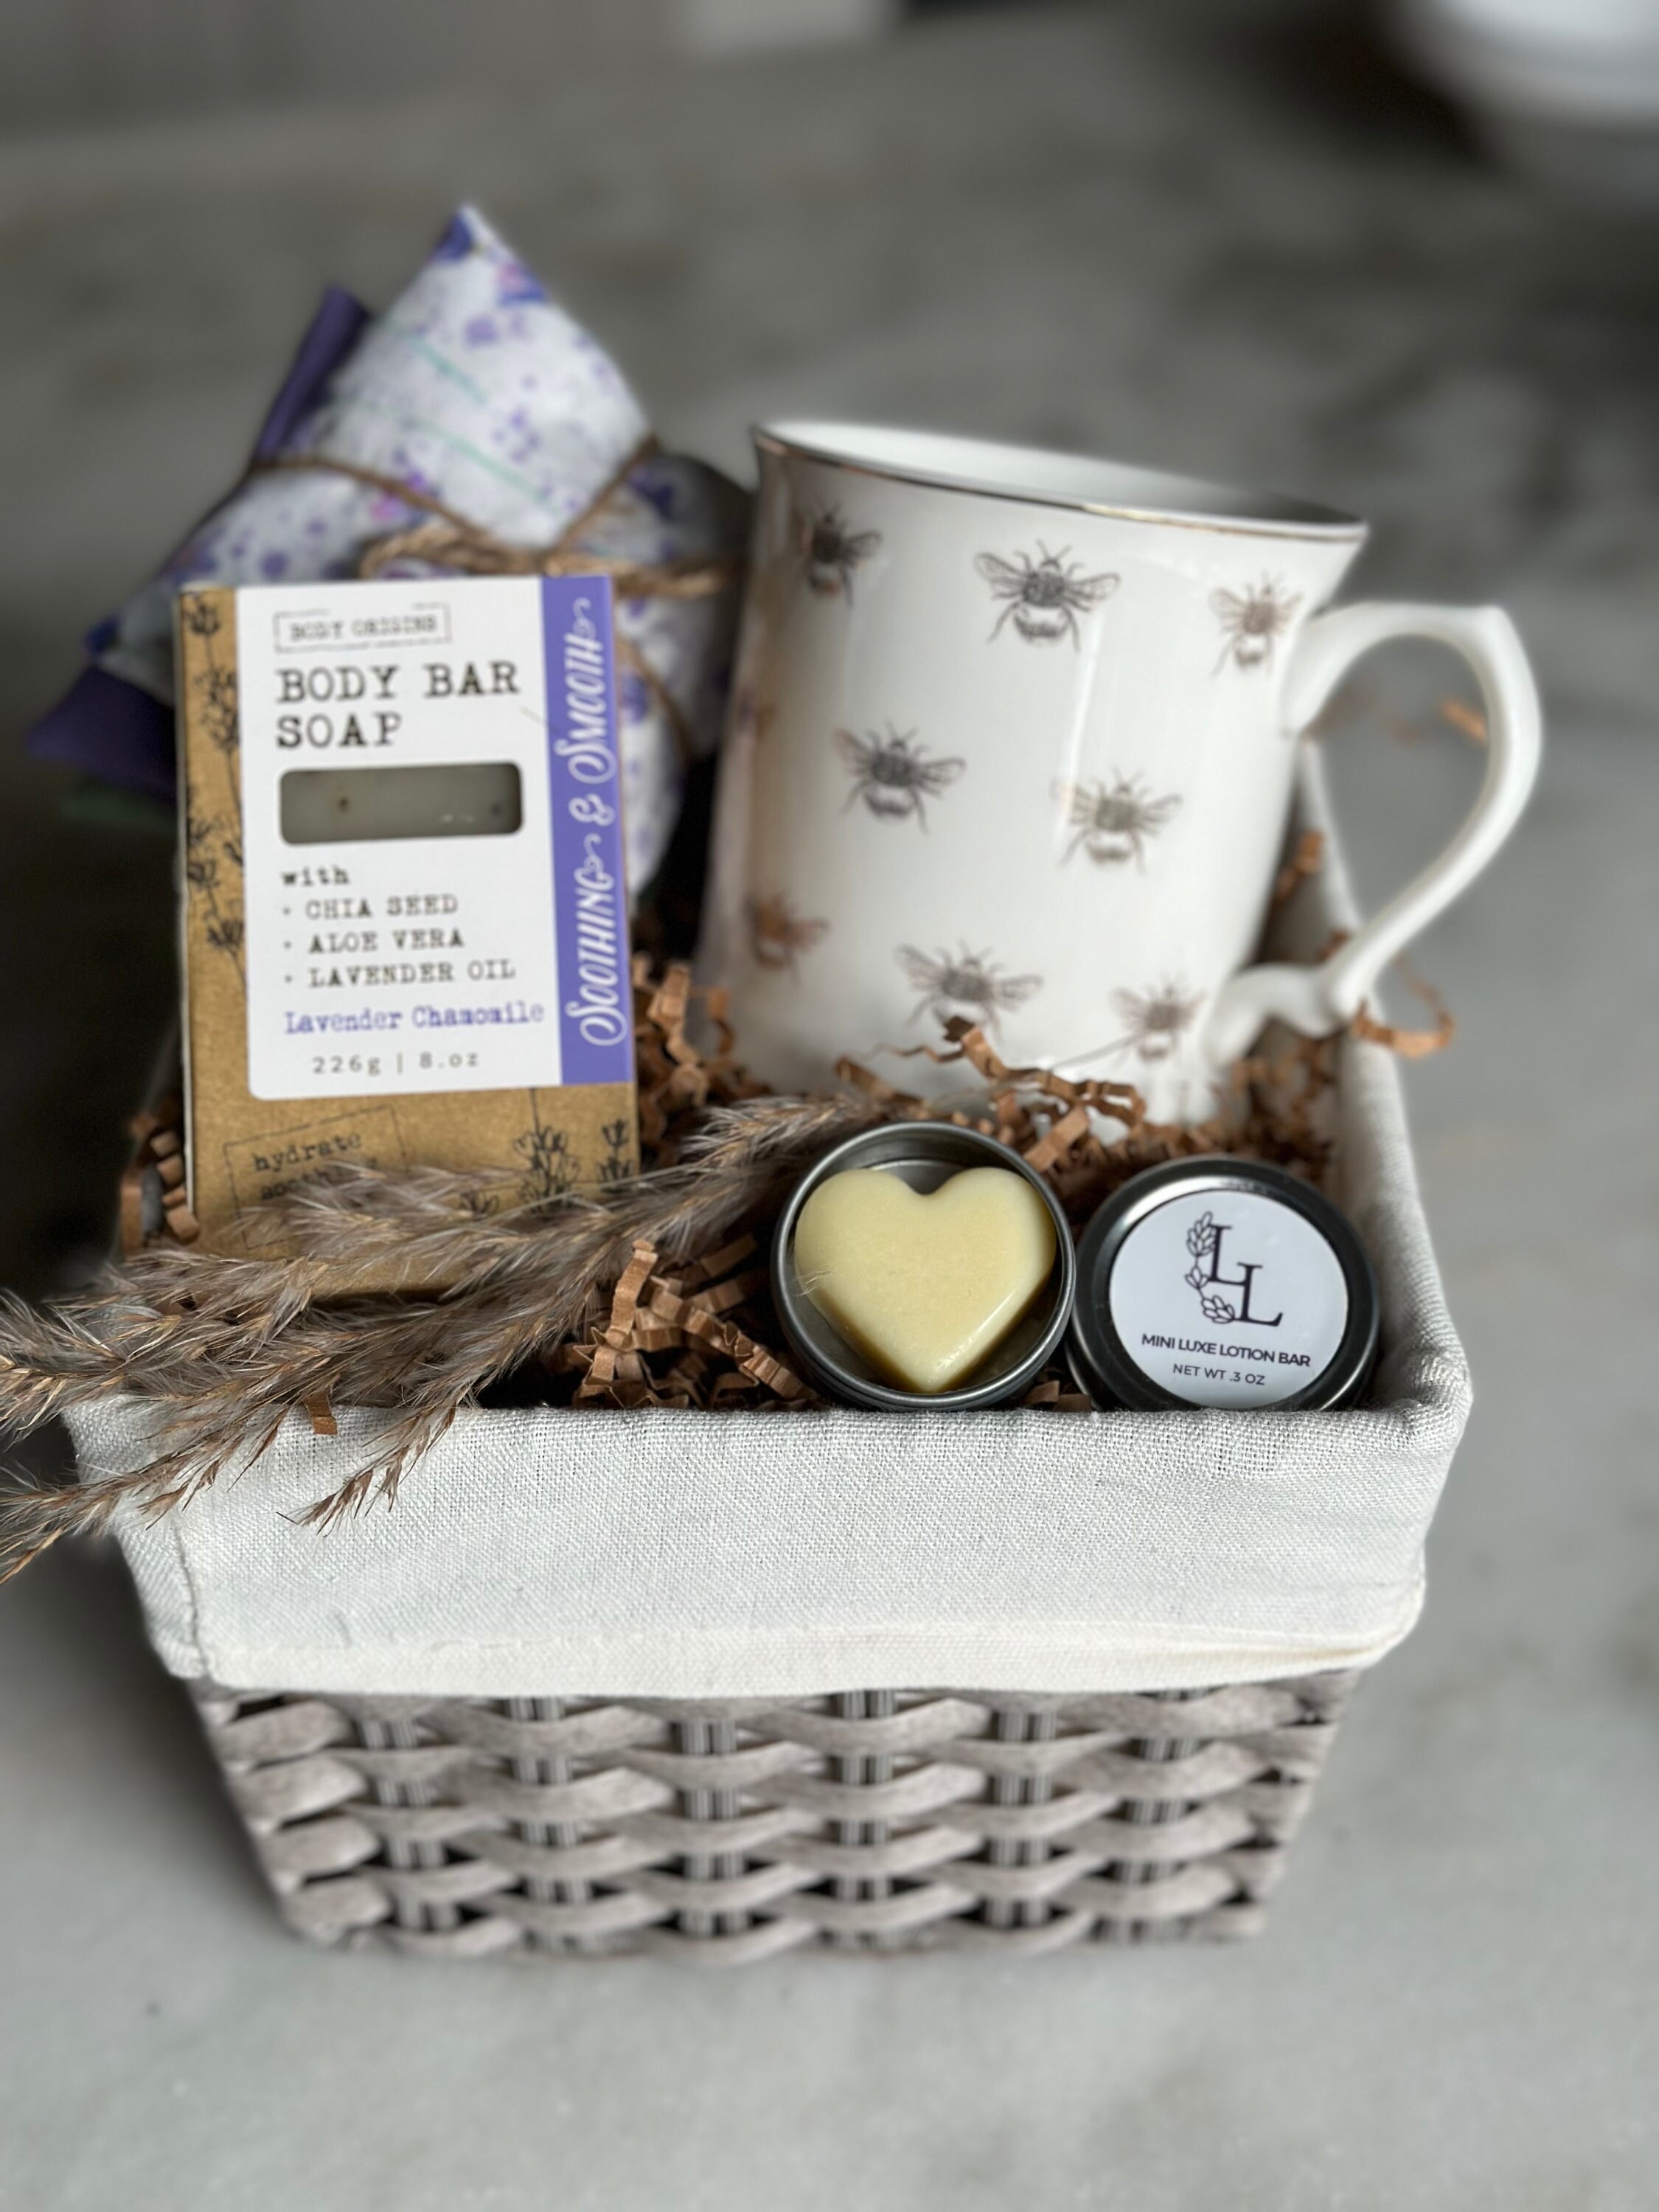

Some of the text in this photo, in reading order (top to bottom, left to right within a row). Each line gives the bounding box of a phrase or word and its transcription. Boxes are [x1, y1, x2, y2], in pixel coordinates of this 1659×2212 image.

[289, 619, 345, 641] BODY
[275, 660, 521, 703] BODY BAR
[276, 712, 401, 750] SOAP
[568, 793, 616, 827] &
[281, 866, 349, 887] with
[305, 894, 458, 920] CHIA SEED
[308, 928, 465, 955] ALOE VERA
[308, 959, 515, 989] LAVENDER OIL
[285, 1001, 544, 1035] Lavender Chamomile
[313, 1055, 381, 1076] 226g
[253, 1133, 361, 1172] hydrate
[1141, 1333, 1310, 1367] MINI LUXE LOTION BAR
[1173, 1363, 1265, 1385] NET WT .3 OZ
